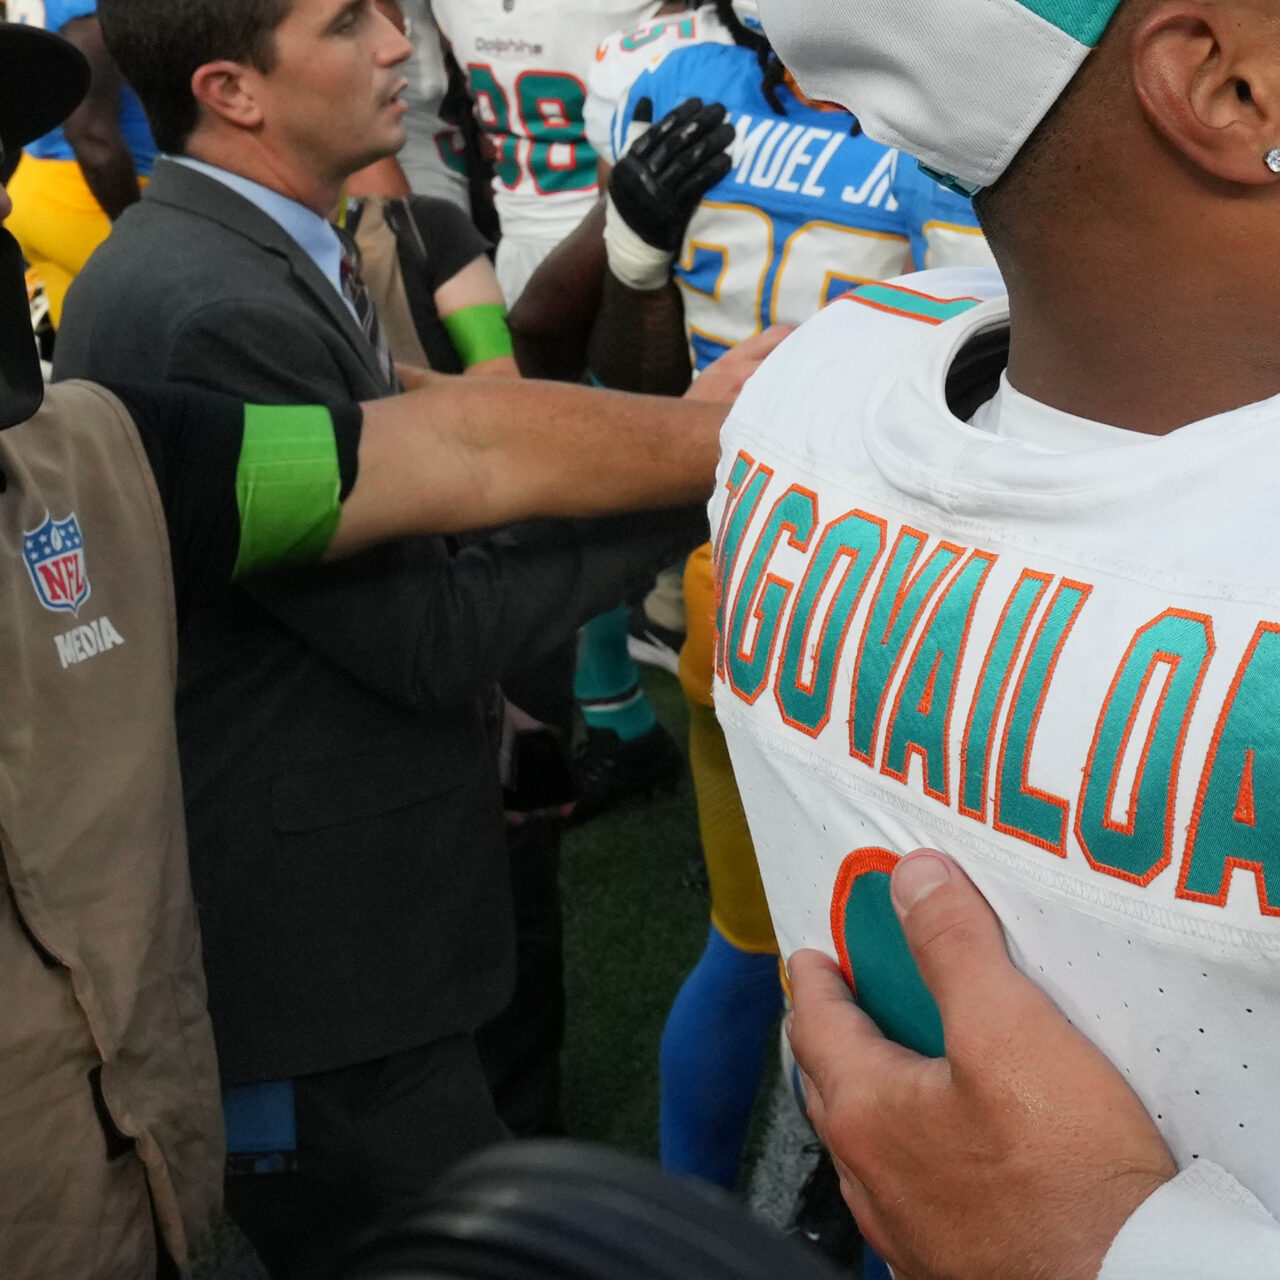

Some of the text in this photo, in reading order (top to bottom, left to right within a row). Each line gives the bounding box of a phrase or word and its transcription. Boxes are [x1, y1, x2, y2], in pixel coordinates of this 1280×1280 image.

[475, 37, 543, 56] Dolphins
[39, 553, 84, 602] NFL
[54, 615, 124, 669] MEDIA
